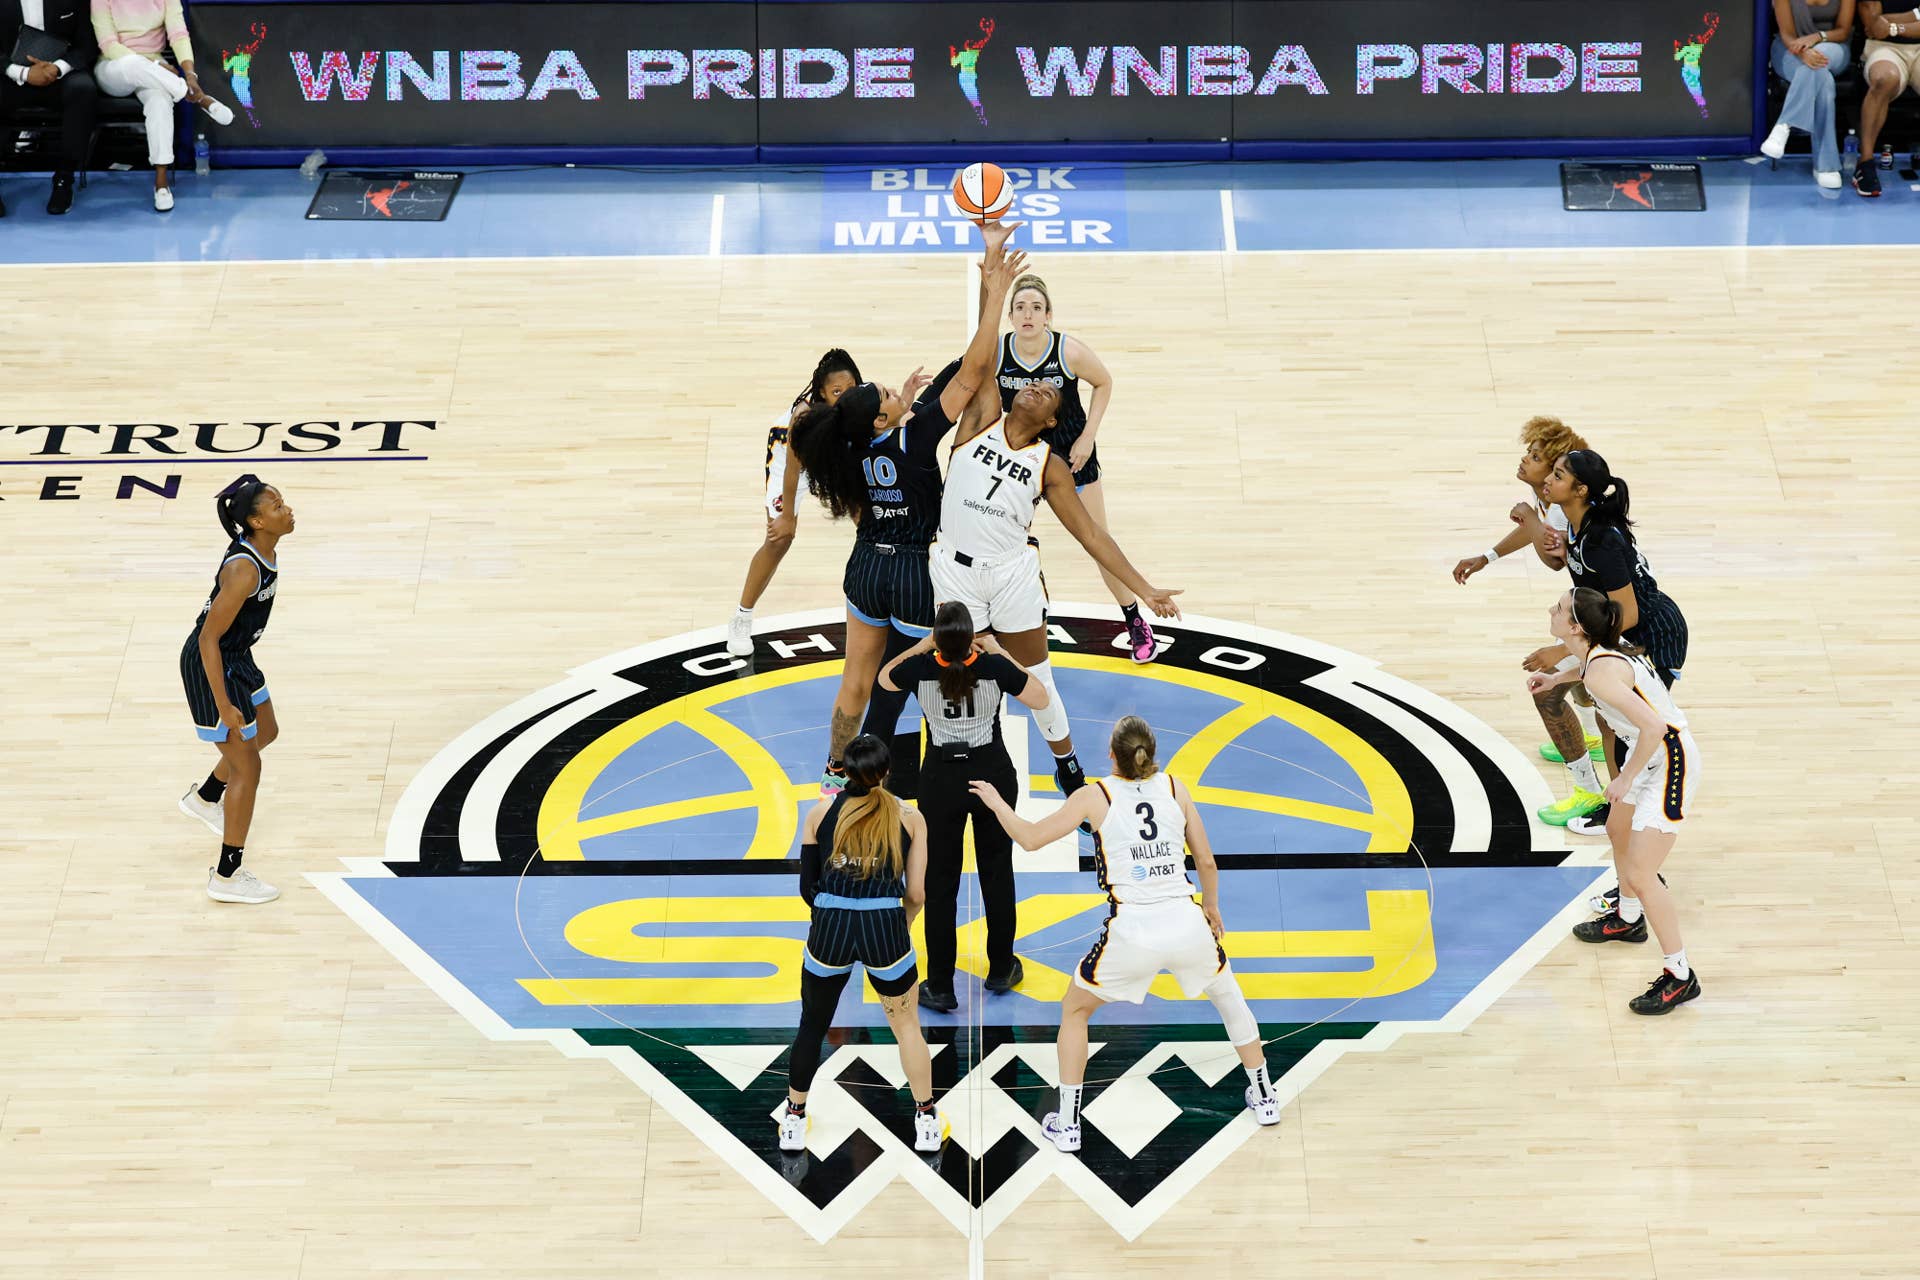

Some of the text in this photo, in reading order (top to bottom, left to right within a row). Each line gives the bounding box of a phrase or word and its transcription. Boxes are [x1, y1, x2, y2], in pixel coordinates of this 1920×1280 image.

[289, 47, 915, 100] WNBA PRIDE
[1015, 42, 1642, 96] WNBA PRIDE
[0, 420, 437, 455] TRUST
[862, 455, 897, 487] 10
[972, 444, 1032, 486] FEVER
[985, 475, 1003, 501] 7
[883, 506, 909, 519] AT&T
[963, 499, 1006, 518] salesforce
[1135, 802, 1158, 841] 3
[1130, 842, 1172, 860] WALLACE
[1149, 863, 1175, 877] AT&T
